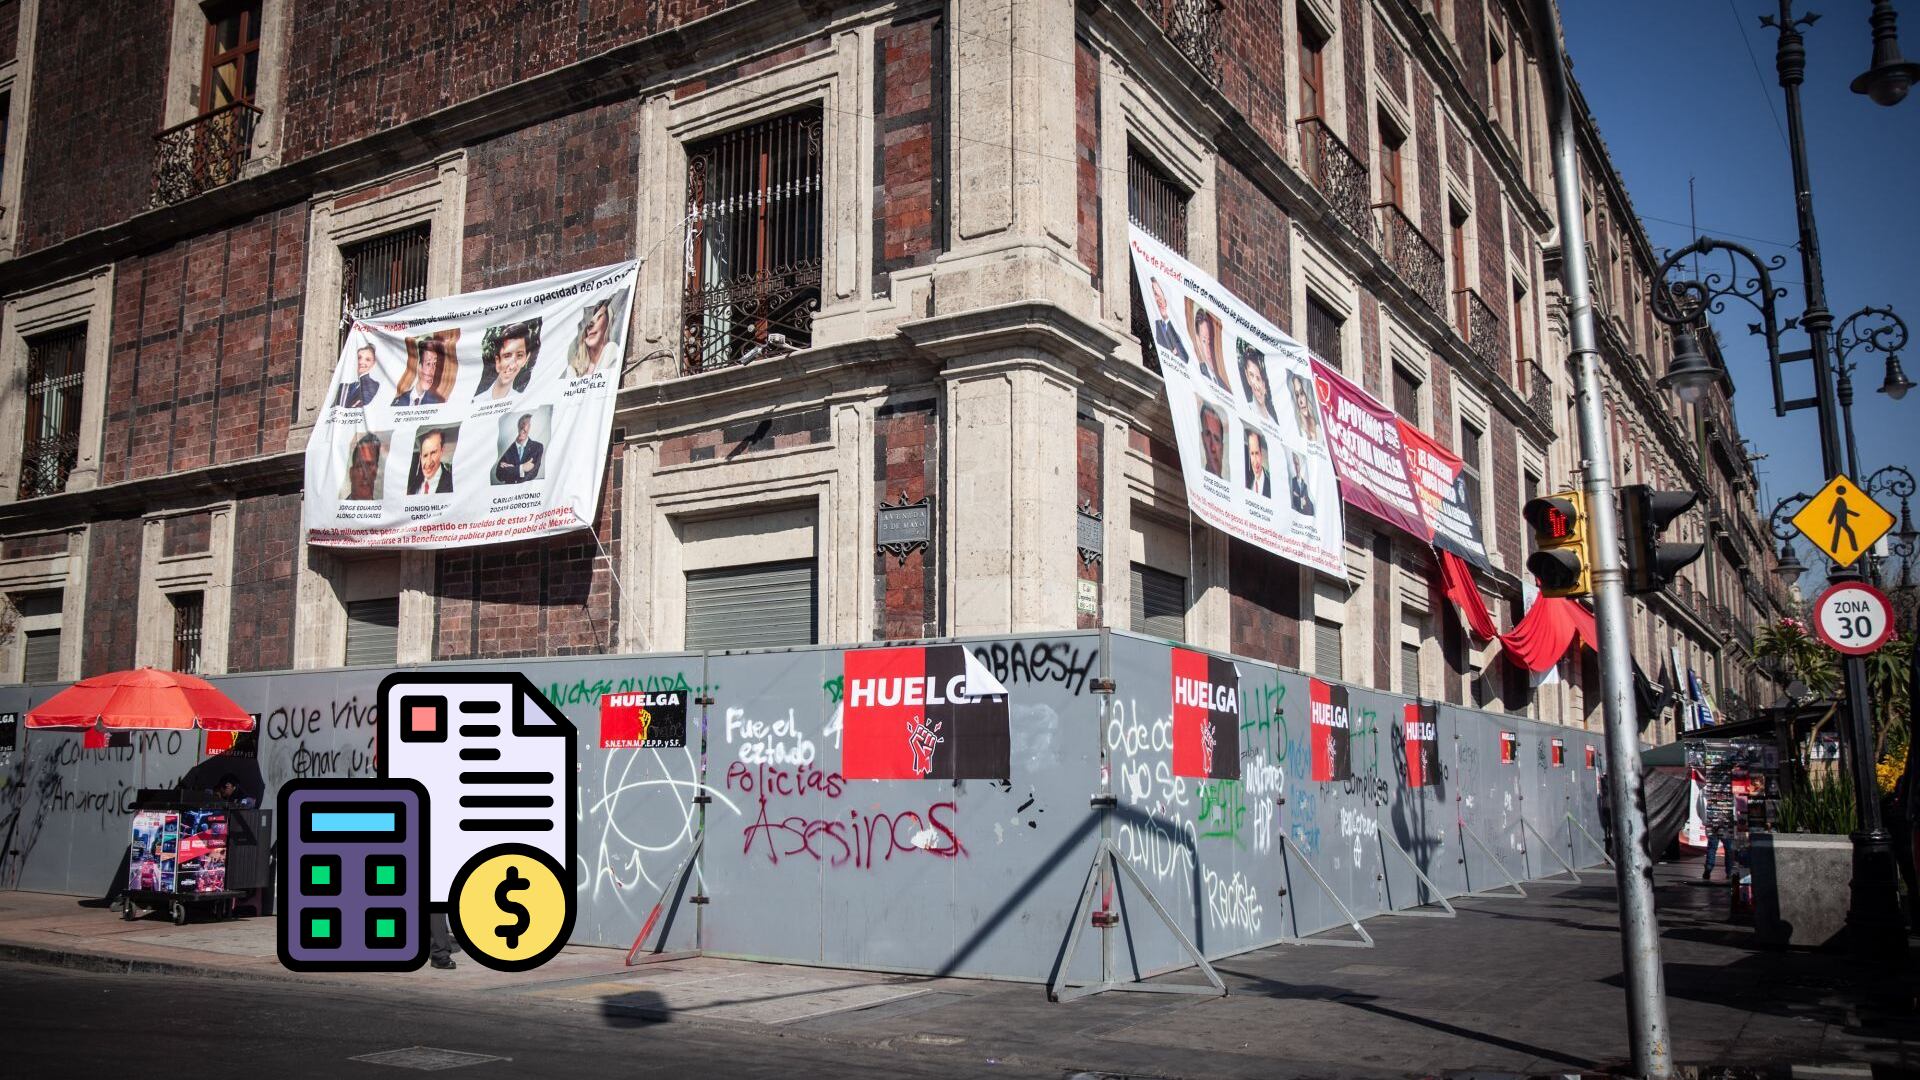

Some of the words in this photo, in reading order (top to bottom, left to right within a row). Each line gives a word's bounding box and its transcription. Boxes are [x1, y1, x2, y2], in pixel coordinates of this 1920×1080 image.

[533, 285, 578, 304] opacidad
[1183, 277, 1200, 293] miles
[1337, 396, 1384, 446] APOYAMOS
[404, 505, 430, 513] DIONISIO
[419, 522, 456, 534] repartido
[457, 521, 468, 530] en
[496, 517, 506, 526] de
[507, 515, 527, 525] estos
[529, 513, 534, 521] 7
[411, 534, 458, 544] Beneficencia
[486, 530, 502, 540] para
[1834, 600, 1870, 614] ZONA
[1838, 616, 1872, 639] 30
[610, 693, 680, 707] HUELGA
[850, 675, 1003, 709] HUELG
[1175, 675, 1238, 714] HUELGA
[725, 706, 770, 744] Fue
[772, 708, 798, 738] el
[1312, 701, 1349, 729] HUELGA
[1406, 722, 1437, 740] HUELGA
